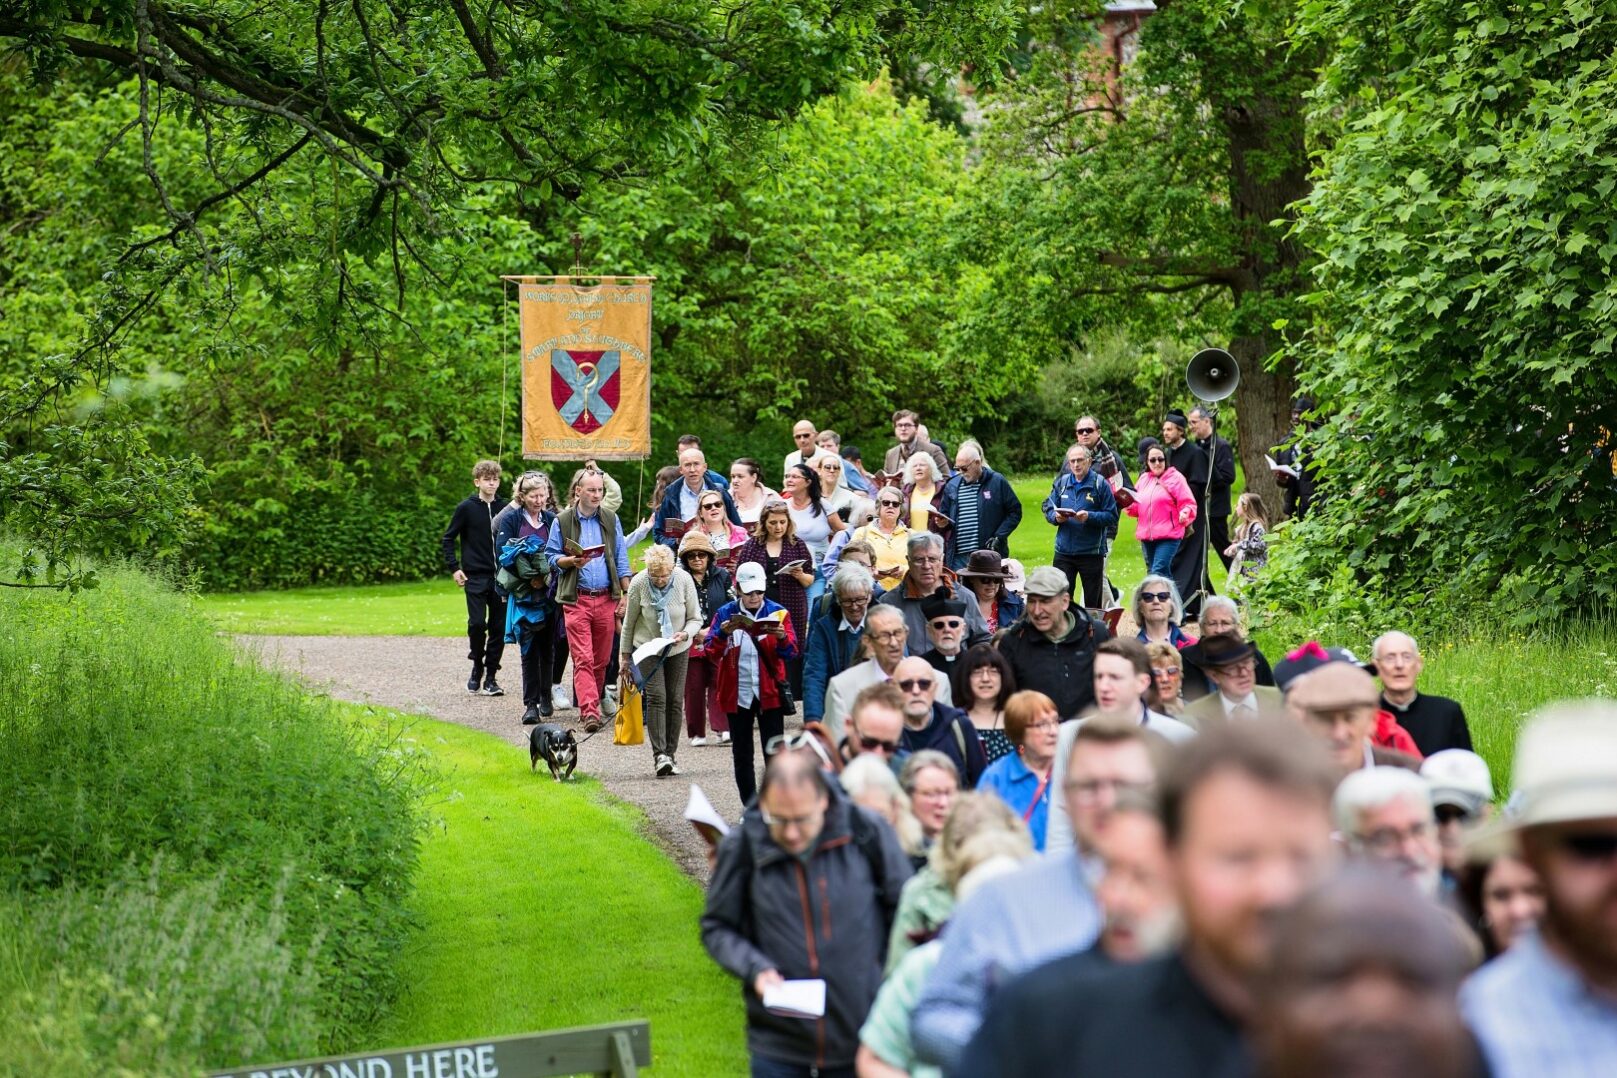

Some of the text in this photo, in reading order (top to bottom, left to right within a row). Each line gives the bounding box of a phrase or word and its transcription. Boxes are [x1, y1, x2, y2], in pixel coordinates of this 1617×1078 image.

[567, 310, 604, 323] PRIORY
[250, 1045, 499, 1078] OND HERE
